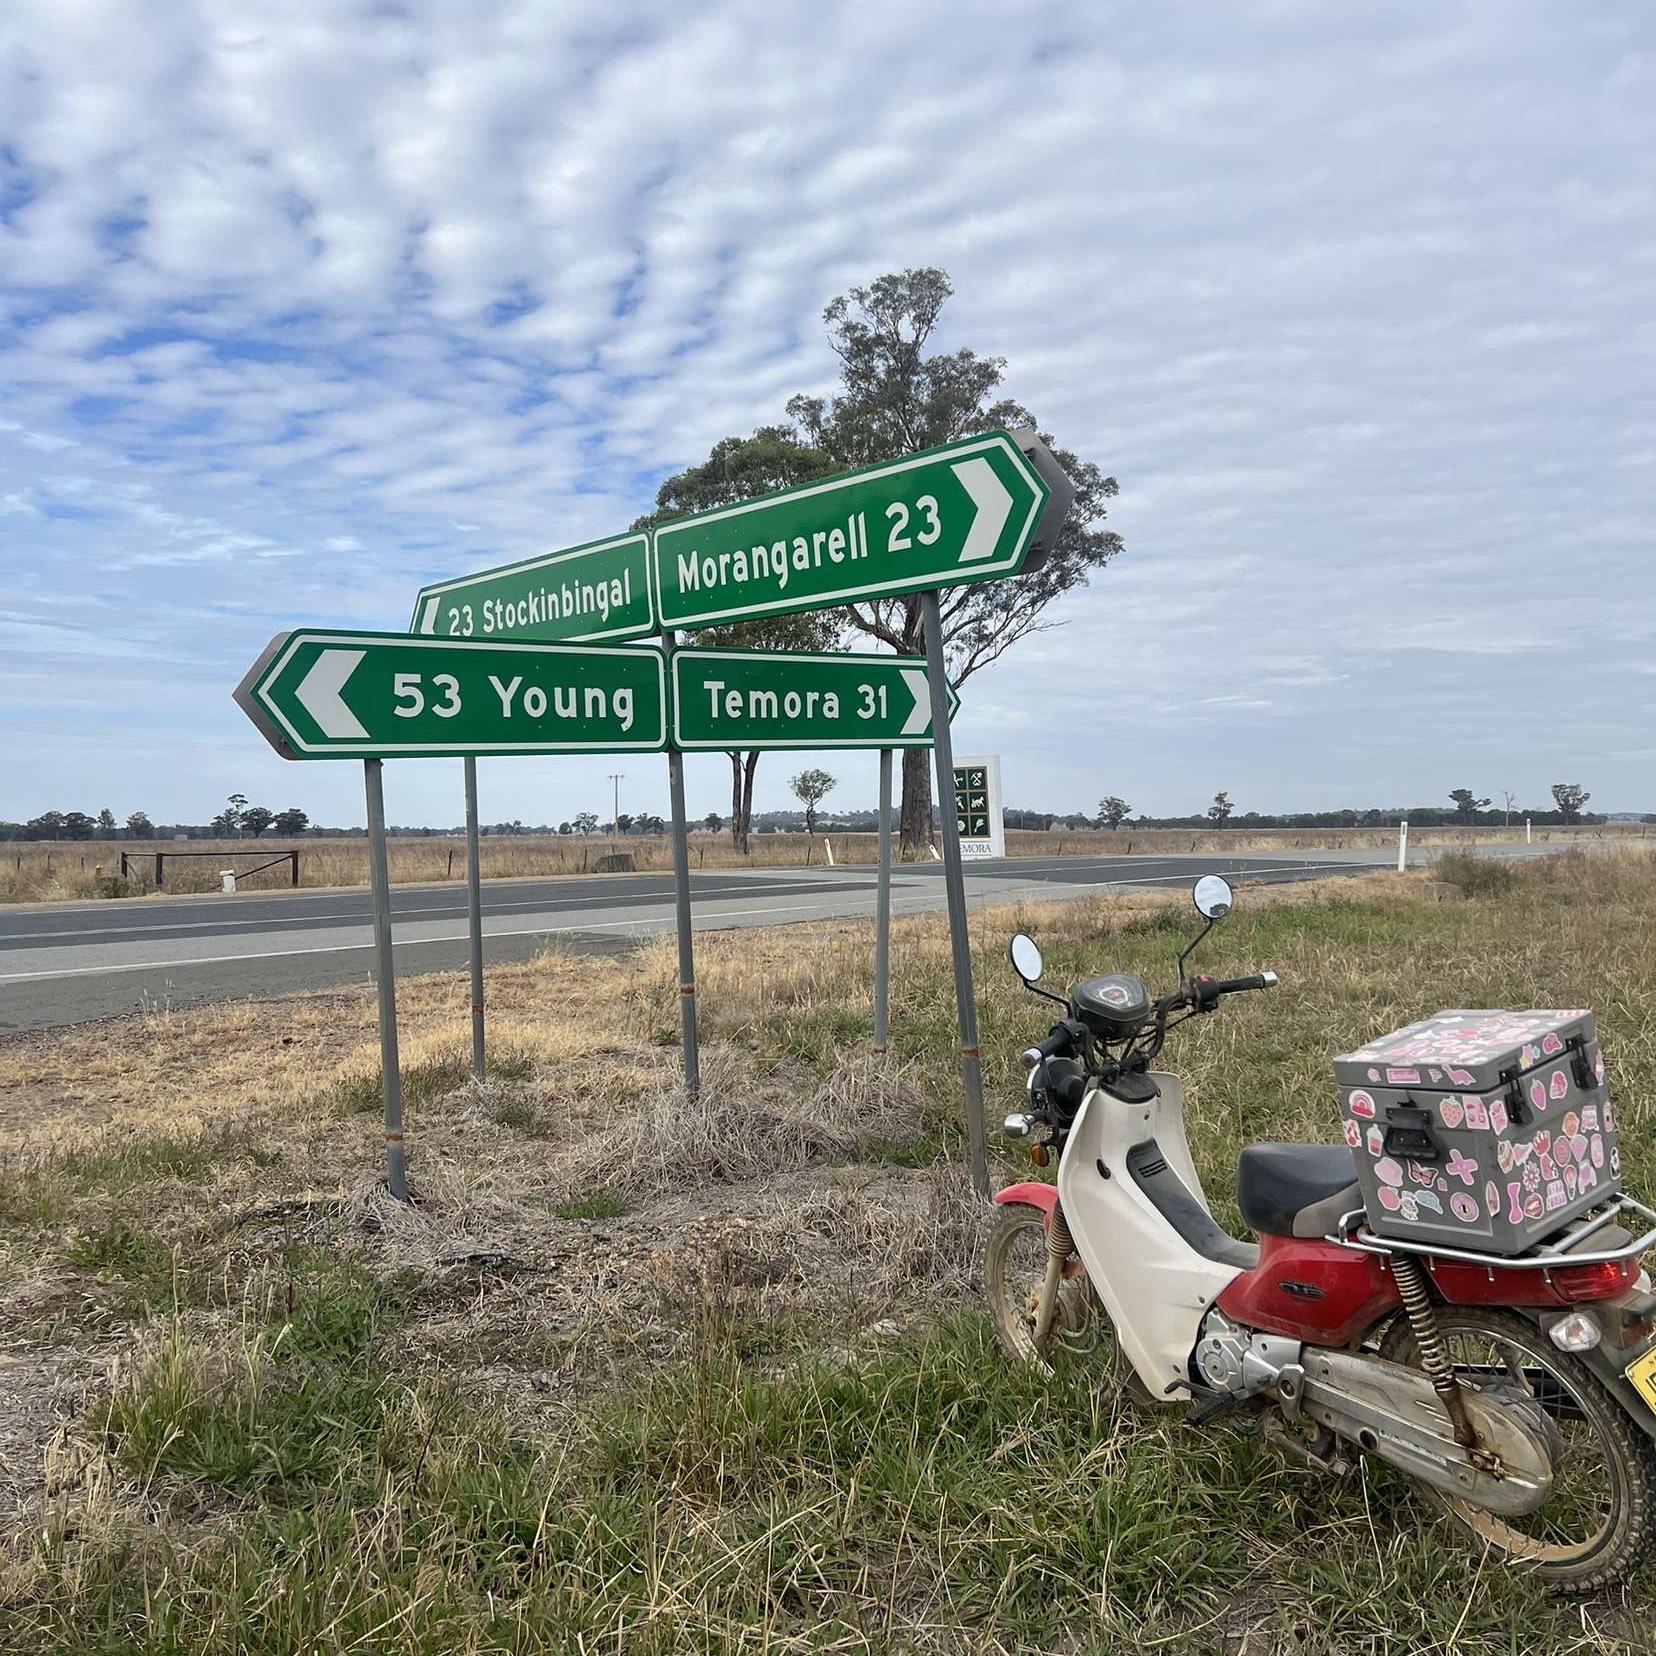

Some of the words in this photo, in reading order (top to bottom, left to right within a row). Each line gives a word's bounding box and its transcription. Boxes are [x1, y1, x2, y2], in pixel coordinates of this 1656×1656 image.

[676, 512, 868, 593] Morangarell
[885, 495, 942, 552] 23
[448, 605, 474, 636] 23
[483, 568, 631, 633] Stockinbingal
[393, 673, 462, 718] 53
[488, 675, 634, 732] Young
[703, 680, 840, 719] Temora
[857, 683, 889, 720] 31
[960, 843, 992, 853] MORA
